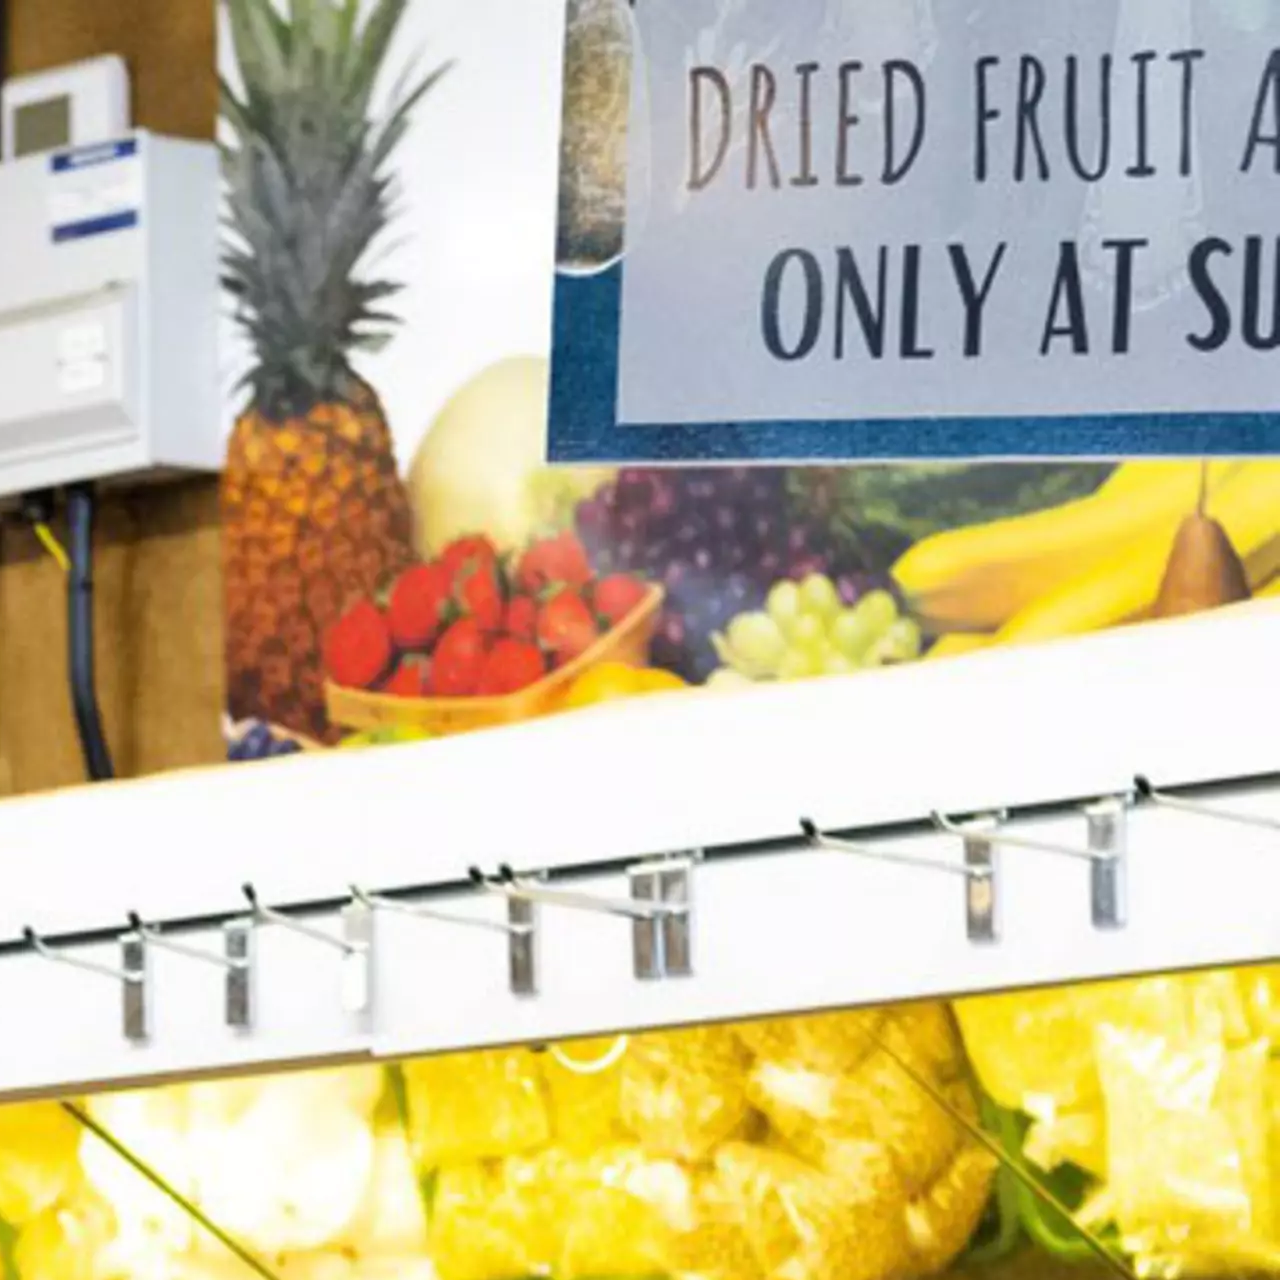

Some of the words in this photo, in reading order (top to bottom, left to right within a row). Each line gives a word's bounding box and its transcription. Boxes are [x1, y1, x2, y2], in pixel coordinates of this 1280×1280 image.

[686, 57, 926, 191] DRIED
[974, 49, 1205, 182] FRUIT
[760, 241, 1008, 361] ONLY
[1040, 238, 1148, 356] AT
[1185, 235, 1280, 352] SU
